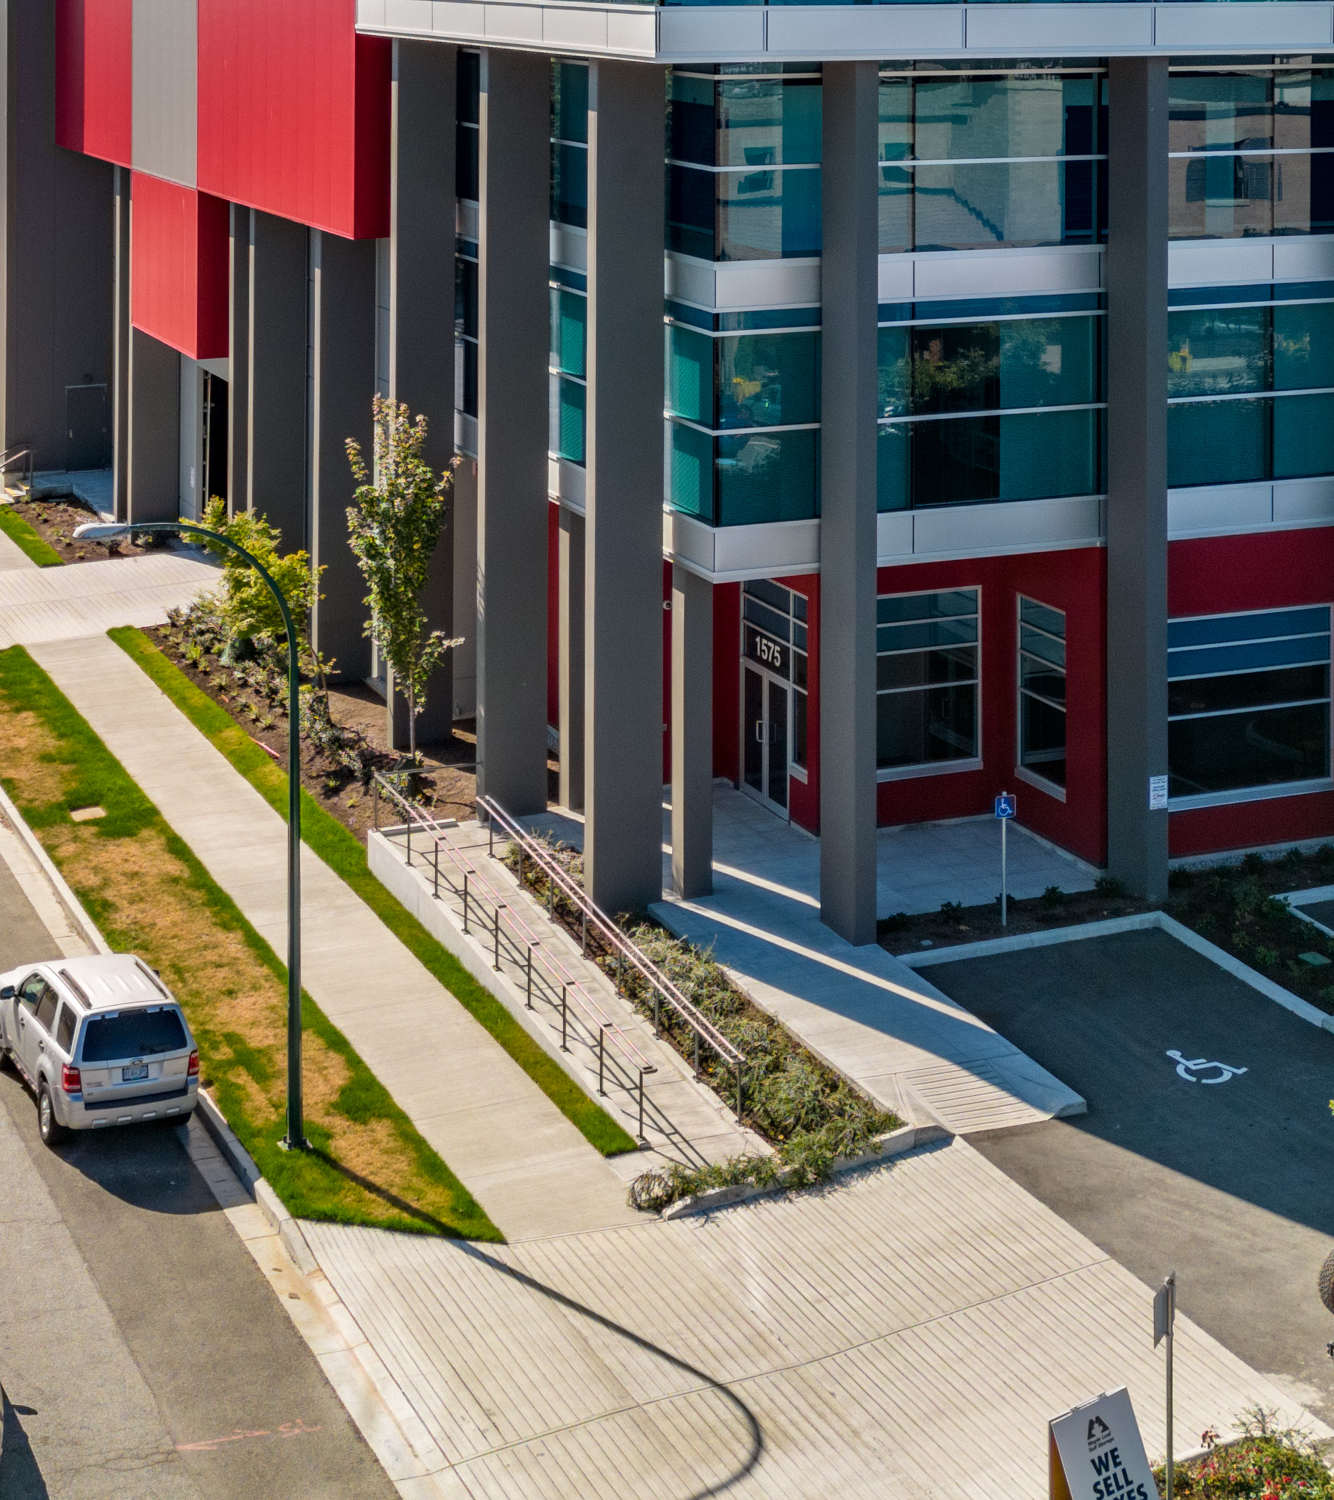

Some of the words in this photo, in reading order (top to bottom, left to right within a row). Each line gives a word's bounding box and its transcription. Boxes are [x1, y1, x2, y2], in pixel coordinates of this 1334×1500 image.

[755, 635, 781, 667] 1575
[1090, 1447, 1122, 1477] WE
[1092, 1467, 1134, 1500] SELL
